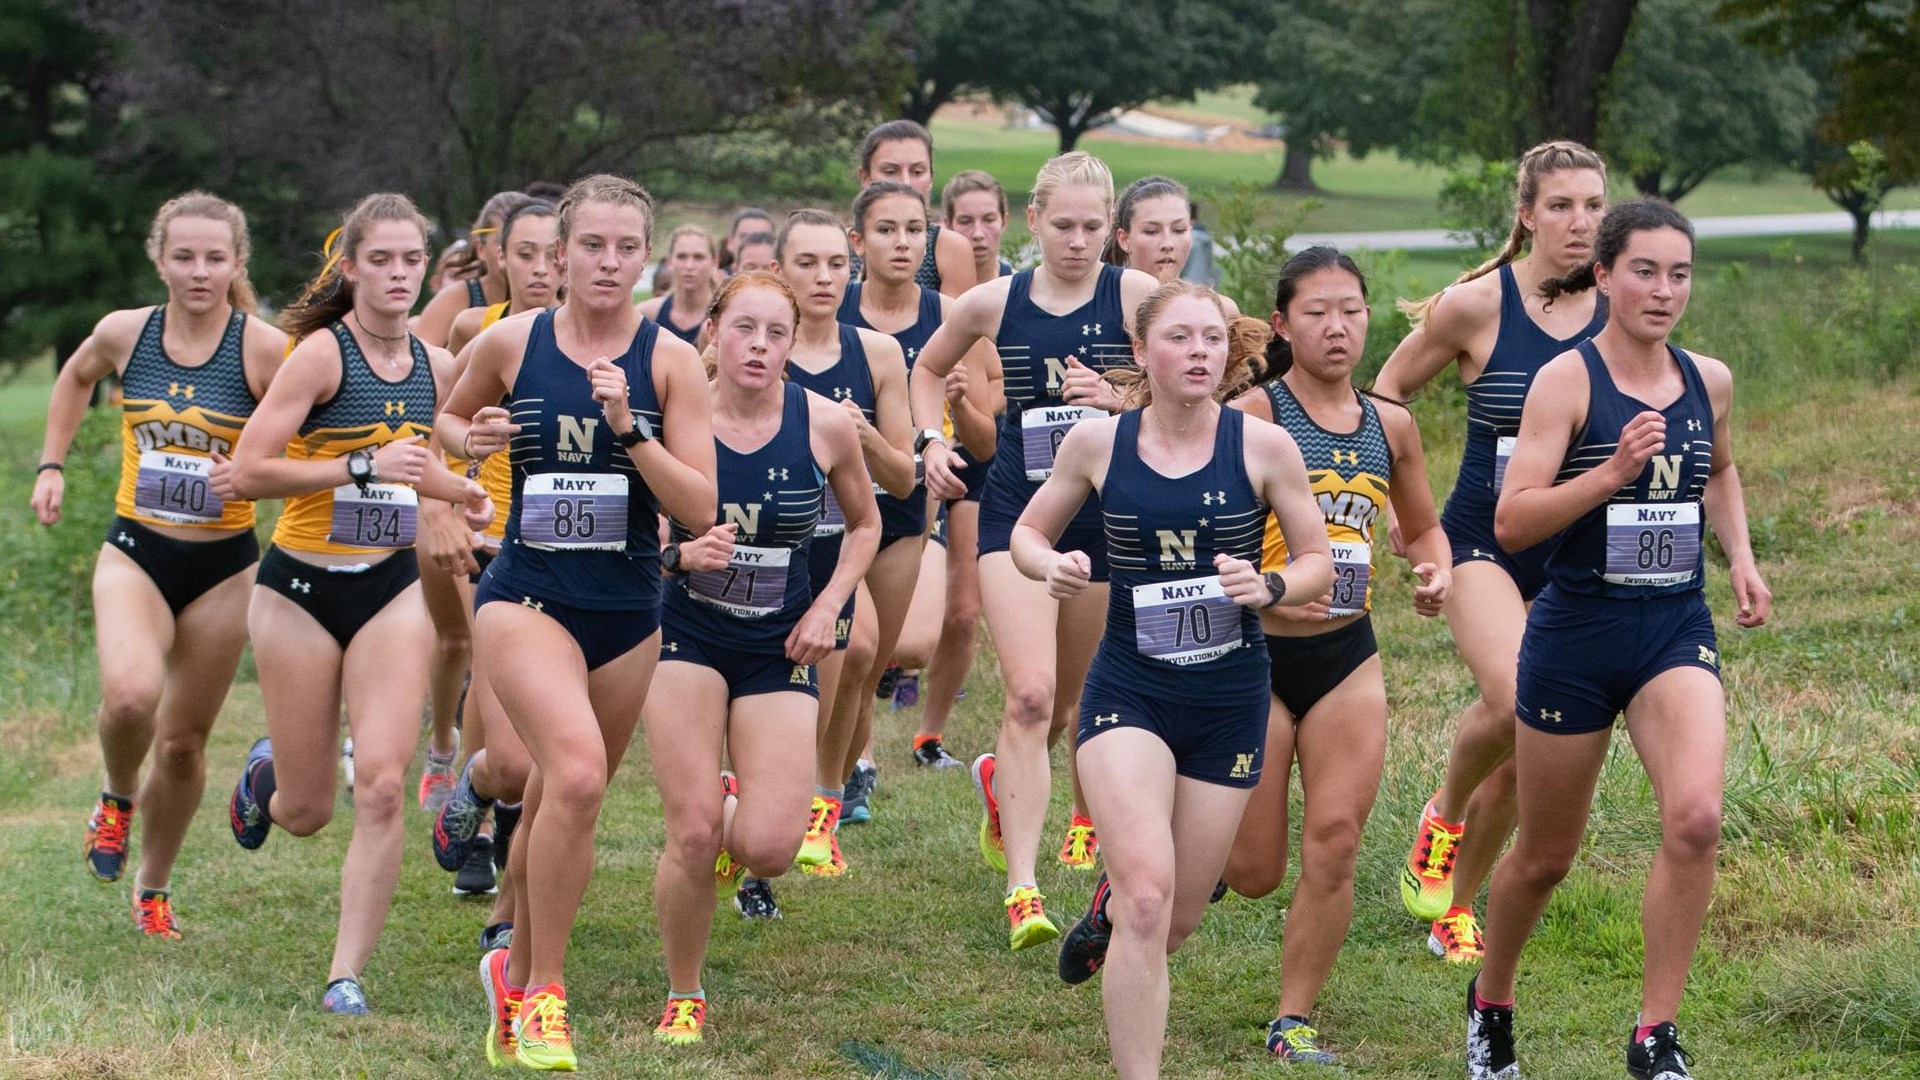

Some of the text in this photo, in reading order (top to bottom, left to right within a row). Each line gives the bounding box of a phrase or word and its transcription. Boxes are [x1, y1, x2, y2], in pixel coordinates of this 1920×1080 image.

[1046, 410, 1083, 422] NAVY
[557, 414, 598, 453] N
[165, 456, 202, 471] NAVY
[558, 452, 592, 464] NAVY
[1650, 455, 1683, 489] N
[553, 478, 597, 490] NAVY
[159, 475, 206, 512] 140
[361, 488, 394, 500] NAVY
[1648, 490, 1677, 500] NAVY
[553, 499, 595, 538] 85
[723, 503, 762, 535] N
[1313, 490, 1379, 543] MBC
[1637, 509, 1677, 521] NAVY
[355, 506, 401, 543] 134
[1156, 530, 1197, 561] N
[1636, 529, 1674, 569] 86
[734, 552, 763, 562] AVY
[1331, 549, 1352, 559] AVY
[1160, 562, 1196, 570] NAVY
[721, 567, 757, 602] 71
[1624, 576, 1676, 585] INVITATIONAL
[1162, 584, 1206, 600] NAVY
[707, 601, 761, 616] VITATIONAL
[1166, 604, 1212, 648] 70
[1232, 754, 1254, 772] N
